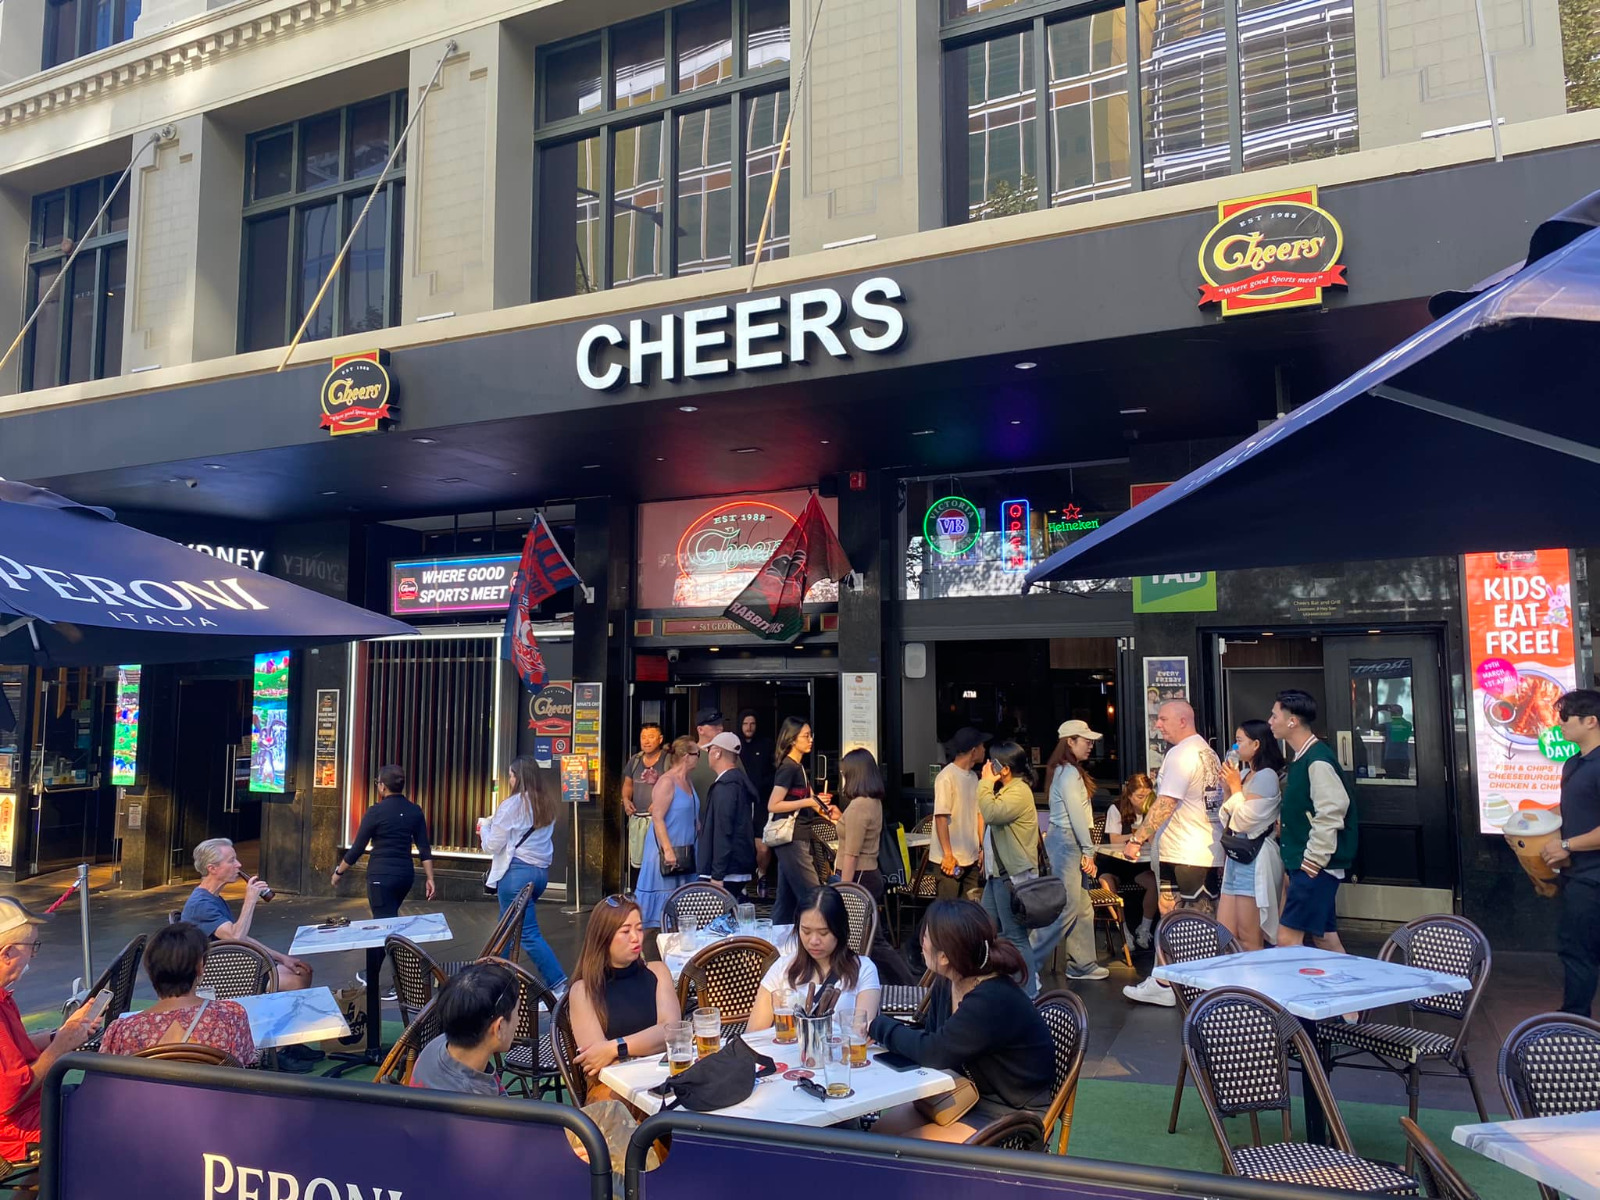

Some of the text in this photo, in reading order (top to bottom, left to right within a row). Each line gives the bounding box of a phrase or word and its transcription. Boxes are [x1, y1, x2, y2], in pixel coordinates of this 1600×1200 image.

[1239, 215, 1262, 228] EST
[1213, 231, 1325, 272] Cheers
[1249, 277, 1269, 289] good
[1270, 275, 1296, 285] Sports
[576, 277, 904, 390] CHEERS
[328, 378, 382, 405] Cheers
[713, 513, 766, 524] EST 1988
[930, 500, 975, 519] VICTORIA
[937, 517, 966, 535] VB
[1048, 519, 1100, 533] Heineken
[1010, 504, 1023, 568] OPEN
[687, 527, 784, 569] Cheer
[0, 555, 270, 611] PERONI
[422, 566, 505, 584] WHERE GOOD
[419, 585, 509, 603] SPORTS MEET
[1484, 576, 1546, 601] KIDS
[108, 611, 218, 627] ITALIA
[1494, 603, 1540, 628] EAT
[1486, 629, 1559, 655] FREE!
[1482, 669, 1505, 678] MARCH
[963, 690, 977, 698] ATM
[534, 697, 572, 717] Cheers
[1545, 731, 1564, 744] AL
[1545, 744, 1575, 759] DAY!
[1489, 782, 1529, 790] CHICKEN
[202, 1152, 403, 1200] PER
